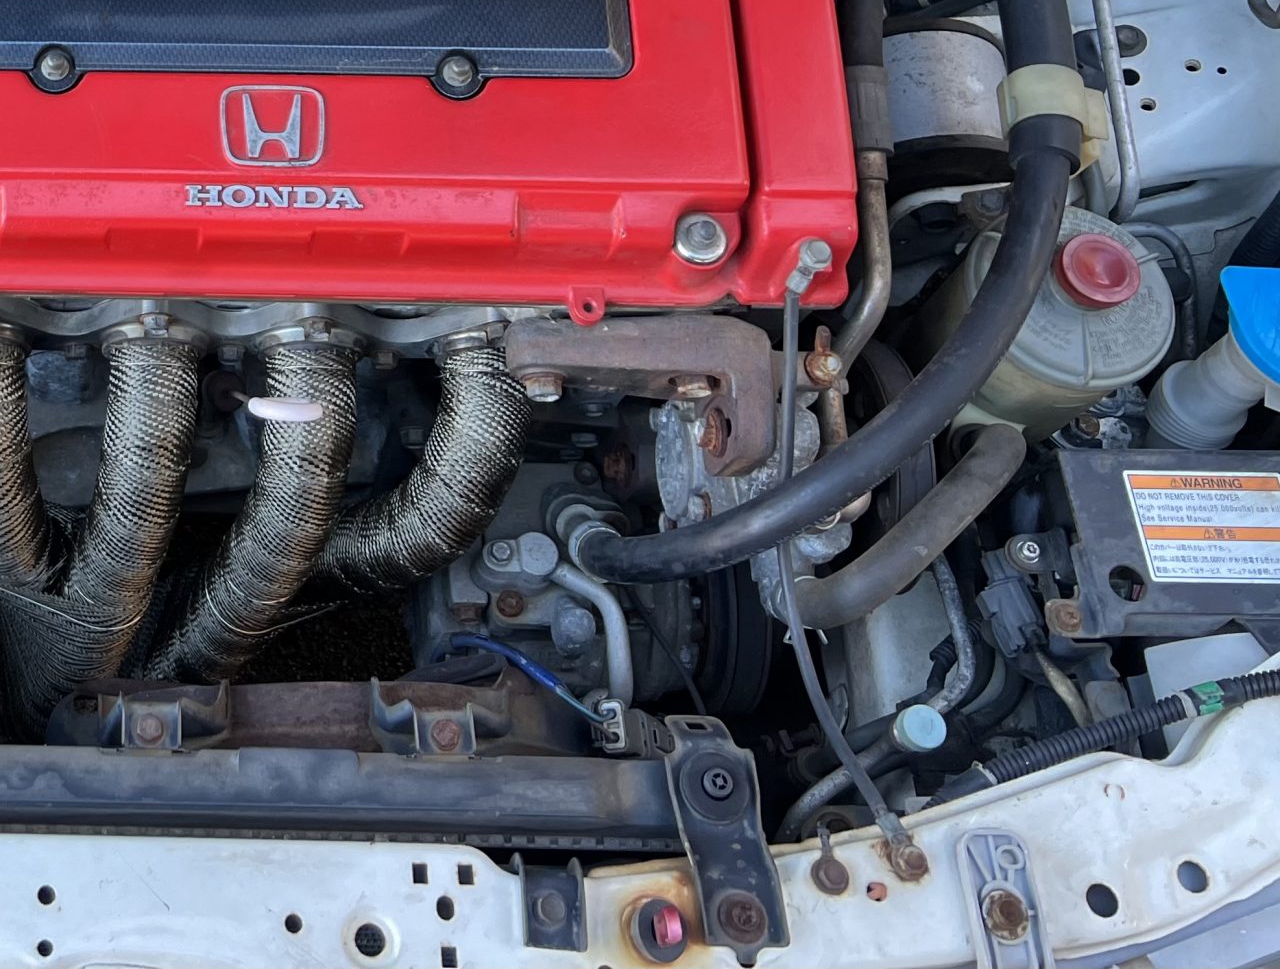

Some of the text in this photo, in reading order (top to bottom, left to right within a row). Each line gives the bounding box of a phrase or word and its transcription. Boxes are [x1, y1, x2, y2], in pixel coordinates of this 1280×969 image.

[185, 184, 364, 209] HONDA
[1180, 478, 1243, 489] WARNING
[1135, 492, 1147, 500] DO
[1148, 493, 1162, 501] NOT
[1164, 493, 1195, 501] REMOVE
[1197, 493, 1213, 501] THIS
[1139, 504, 1154, 512] High
[1156, 505, 1183, 513] voltage
[1142, 514, 1154, 522] See
[1157, 515, 1185, 523] Service
[1214, 528, 1237, 540] 警告
